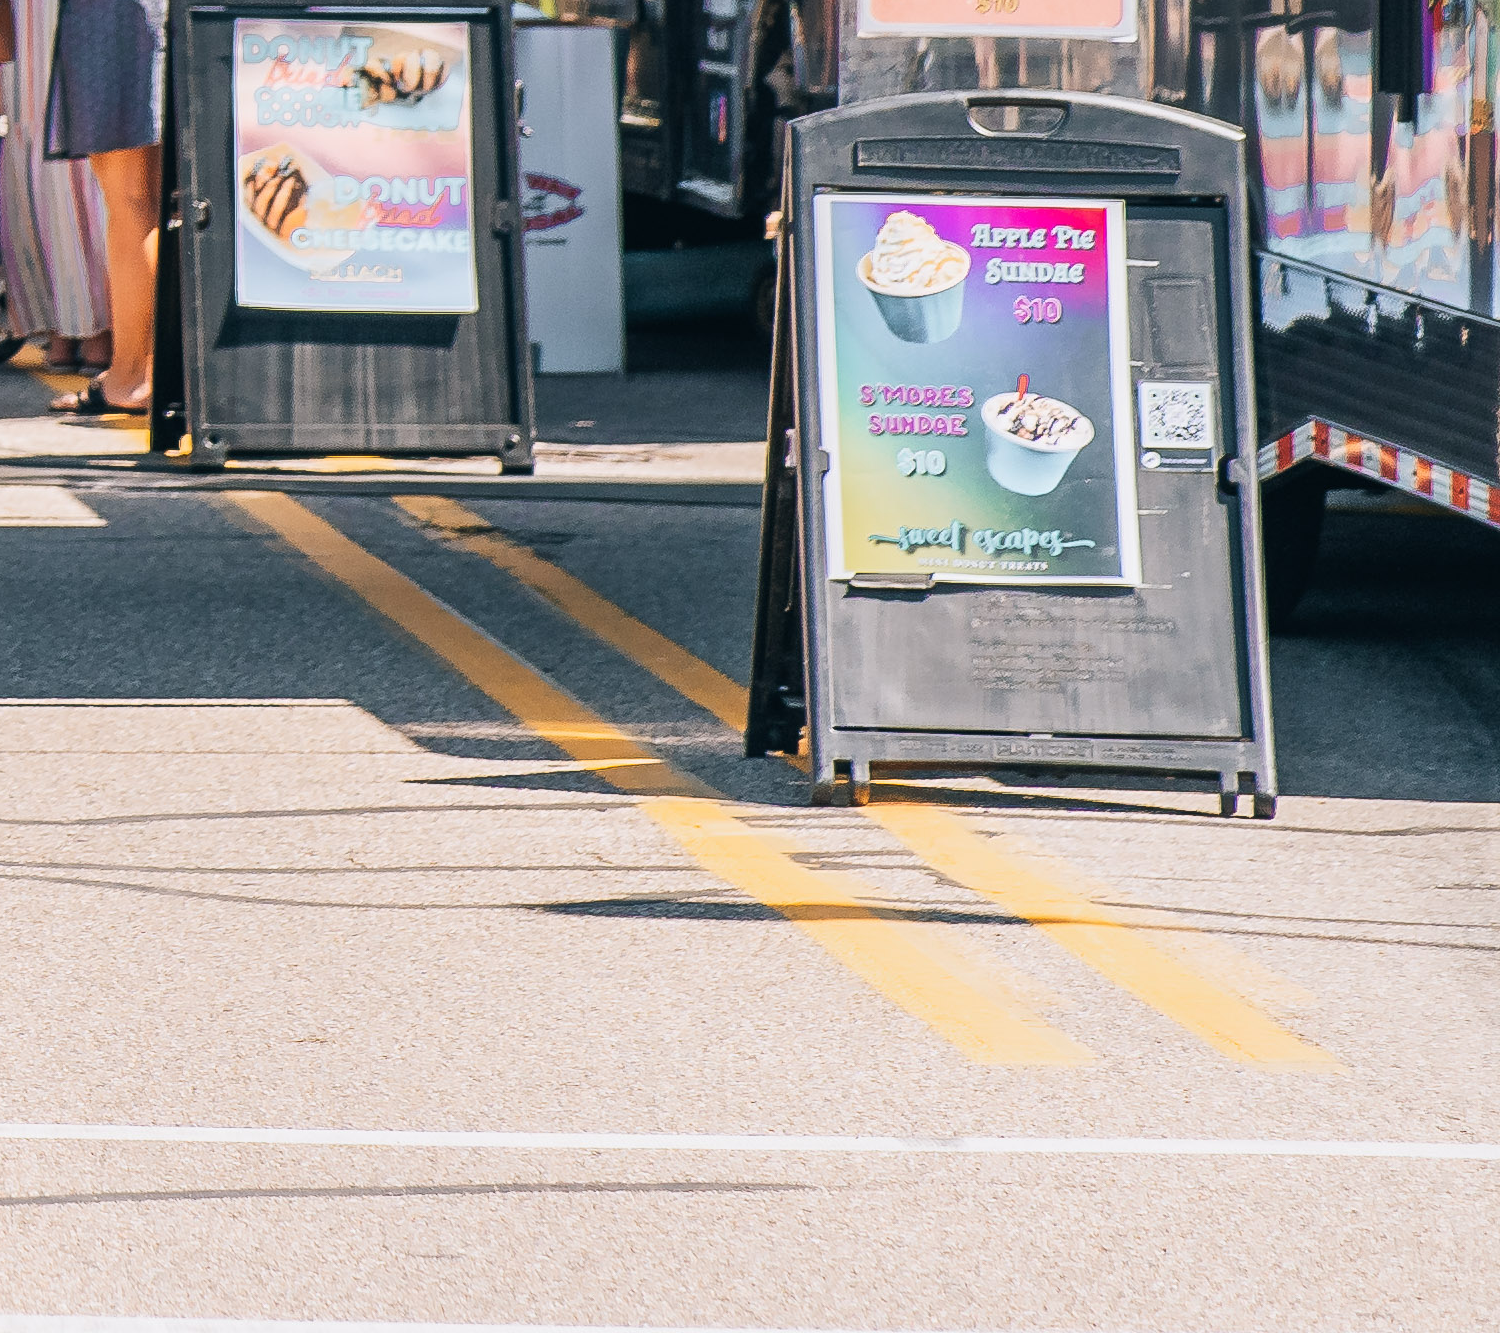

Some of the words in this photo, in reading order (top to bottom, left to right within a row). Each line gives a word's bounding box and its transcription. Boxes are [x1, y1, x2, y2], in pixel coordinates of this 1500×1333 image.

[242, 33, 374, 71] DONUT
[334, 175, 467, 206] DONUT
[291, 227, 468, 252] CHEESECAKE
[1013, 295, 1062, 323] $10
[858, 385, 974, 407] S'MORES
[868, 414, 969, 436] SUNDAE
[897, 448, 946, 477] $10
[868, 519, 965, 552] sweet
[973, 527, 1095, 556] escapes
[1000, 560, 1049, 571] TREATS
